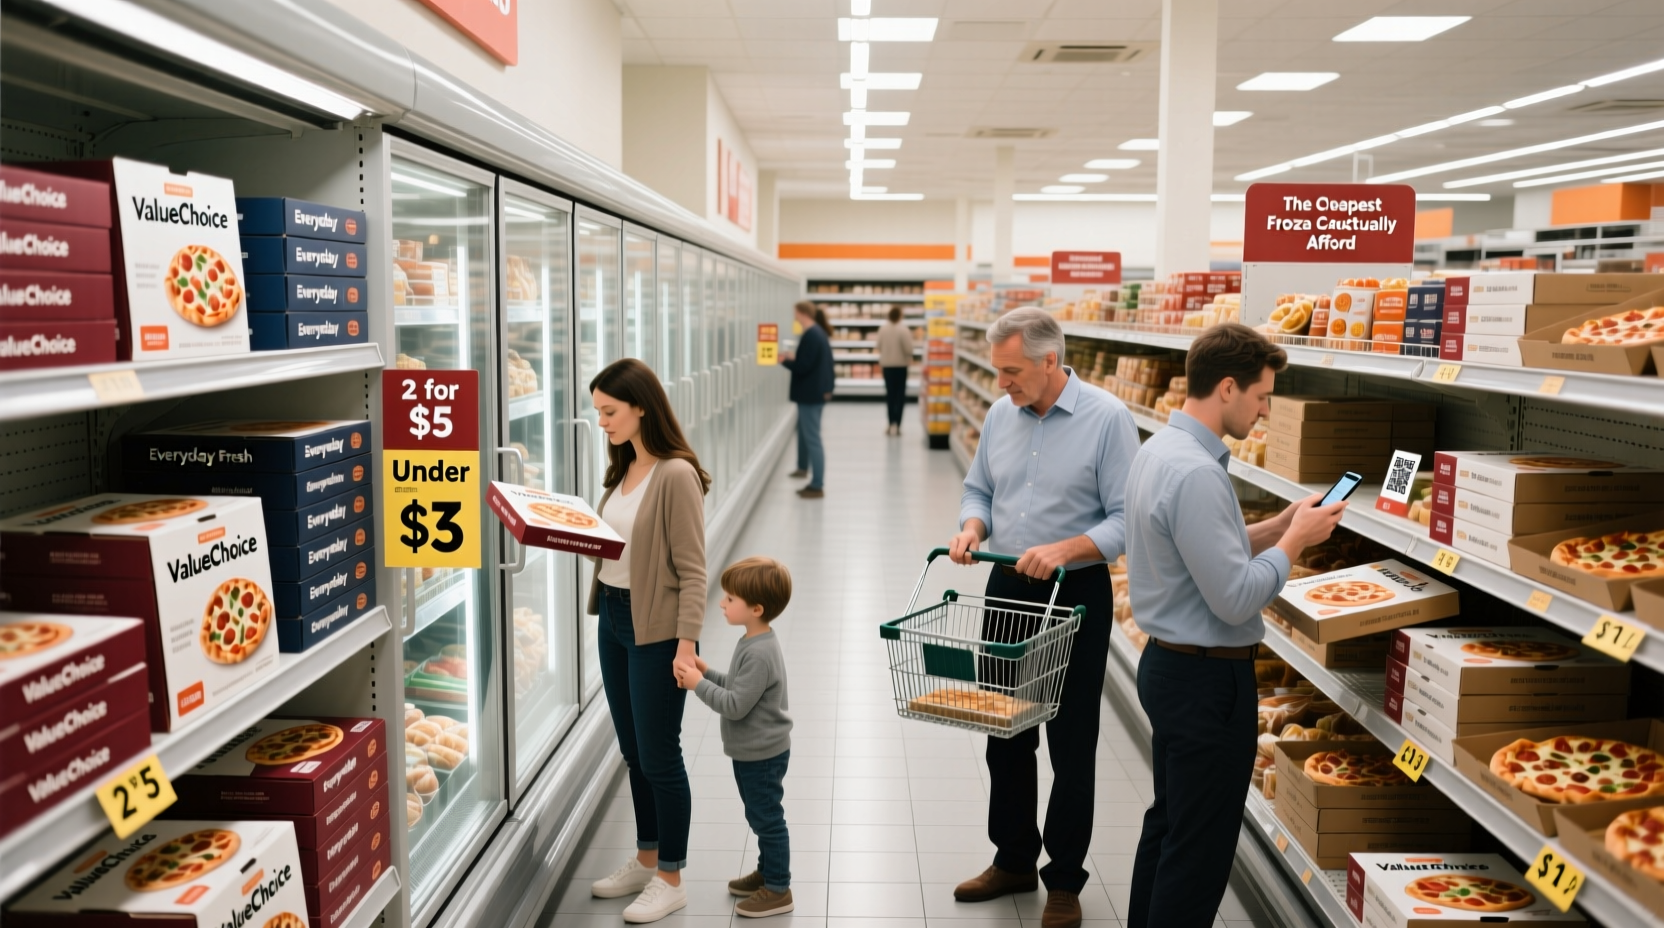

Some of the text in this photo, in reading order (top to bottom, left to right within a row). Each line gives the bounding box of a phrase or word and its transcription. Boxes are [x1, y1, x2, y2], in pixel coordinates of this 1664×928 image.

[131, 196, 229, 229] ValueChoice
[1283, 196, 1312, 212] The
[1306, 234, 1356, 250] Afford
[402, 378, 459, 400] 2 for
[409, 403, 453, 441] $5
[150, 446, 253, 467] Everyday Fresh
[392, 459, 470, 483] Under
[400, 499, 464, 554] $3
[167, 534, 257, 584] ValueChoice
[22, 654, 105, 704] ValueChoice
[24, 700, 107, 754] ValueChoice
[27, 746, 110, 804] ValueChoice
[214, 864, 292, 928] lueChoice
